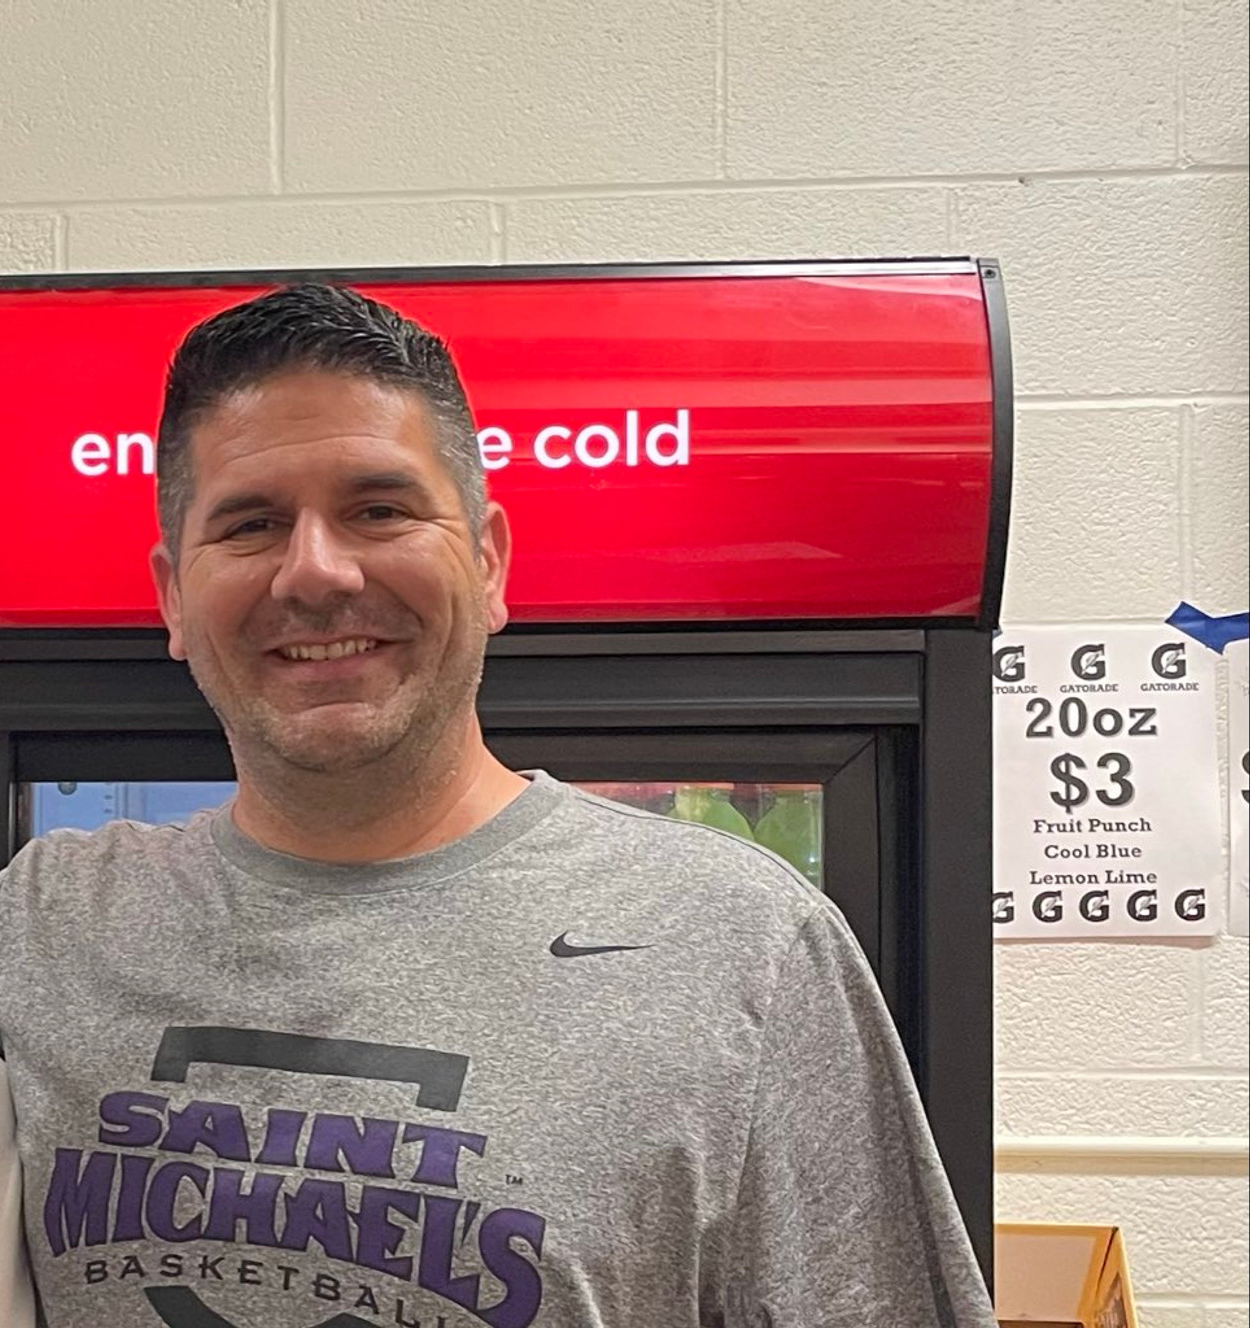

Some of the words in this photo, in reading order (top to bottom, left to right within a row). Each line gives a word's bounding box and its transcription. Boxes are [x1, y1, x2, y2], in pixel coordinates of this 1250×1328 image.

[71, 432, 154, 475] en
[533, 409, 690, 468] cold
[1060, 683, 1119, 694] GATORADE
[1140, 682, 1200, 692] GATORADE
[1025, 696, 1158, 739] 20oz
[1049, 752, 1136, 815] $3
[1033, 818, 1083, 834] Fruit
[1088, 817, 1153, 833] Punch
[1043, 844, 1091, 859] Cool
[1096, 843, 1143, 859] Blue
[1029, 870, 1100, 886] Lemon
[1105, 869, 1158, 885] Lime
[97, 1090, 489, 1190] SAINT
